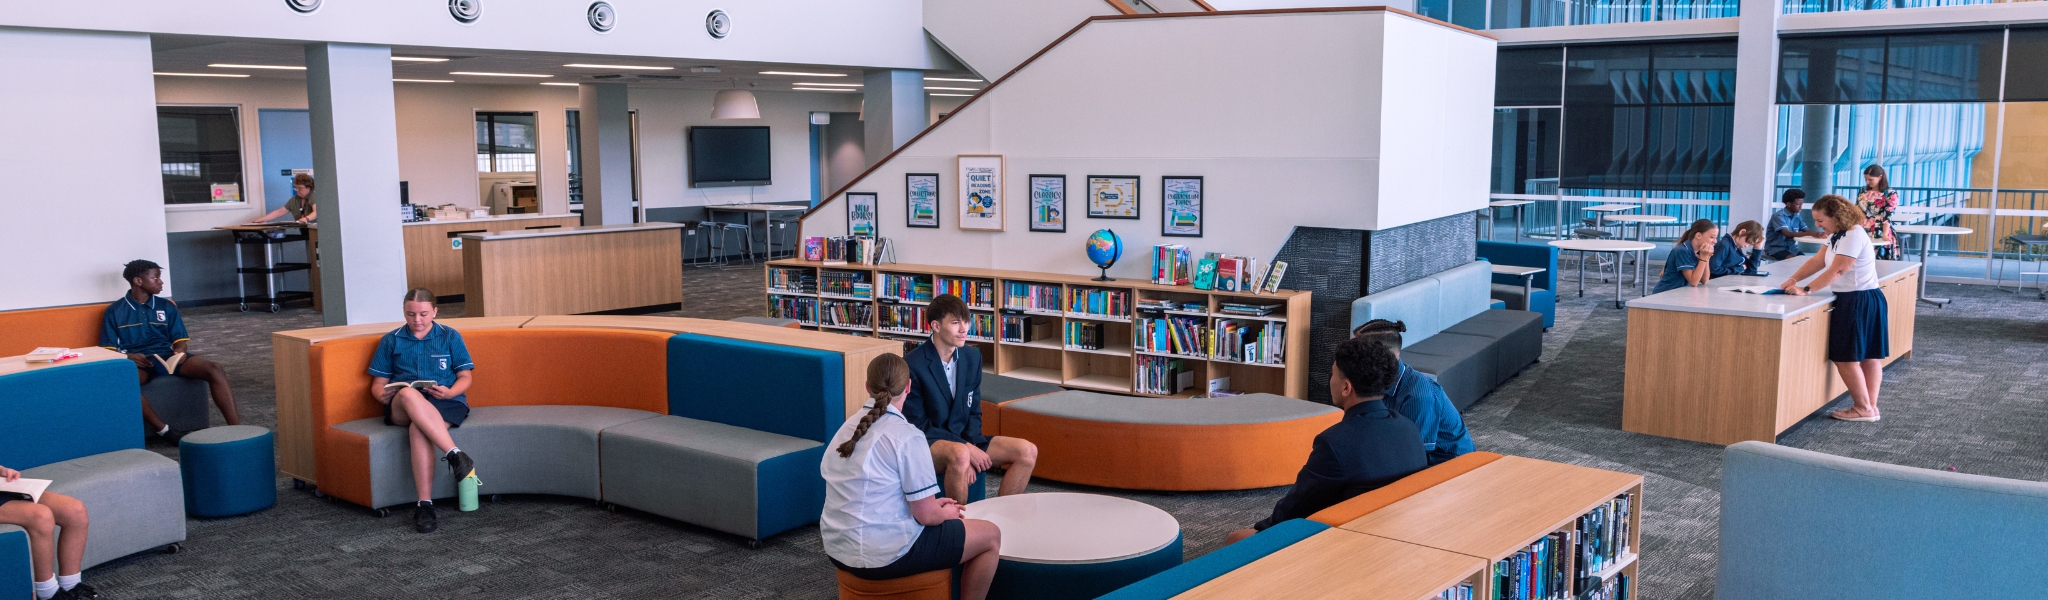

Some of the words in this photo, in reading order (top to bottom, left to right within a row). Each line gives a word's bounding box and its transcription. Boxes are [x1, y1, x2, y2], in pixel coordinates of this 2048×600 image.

[970, 174, 991, 182] QUIET
[1034, 191, 1062, 200] CLASSICS
[855, 204, 870, 212] NEW
[1200, 262, 1213, 273] 365
